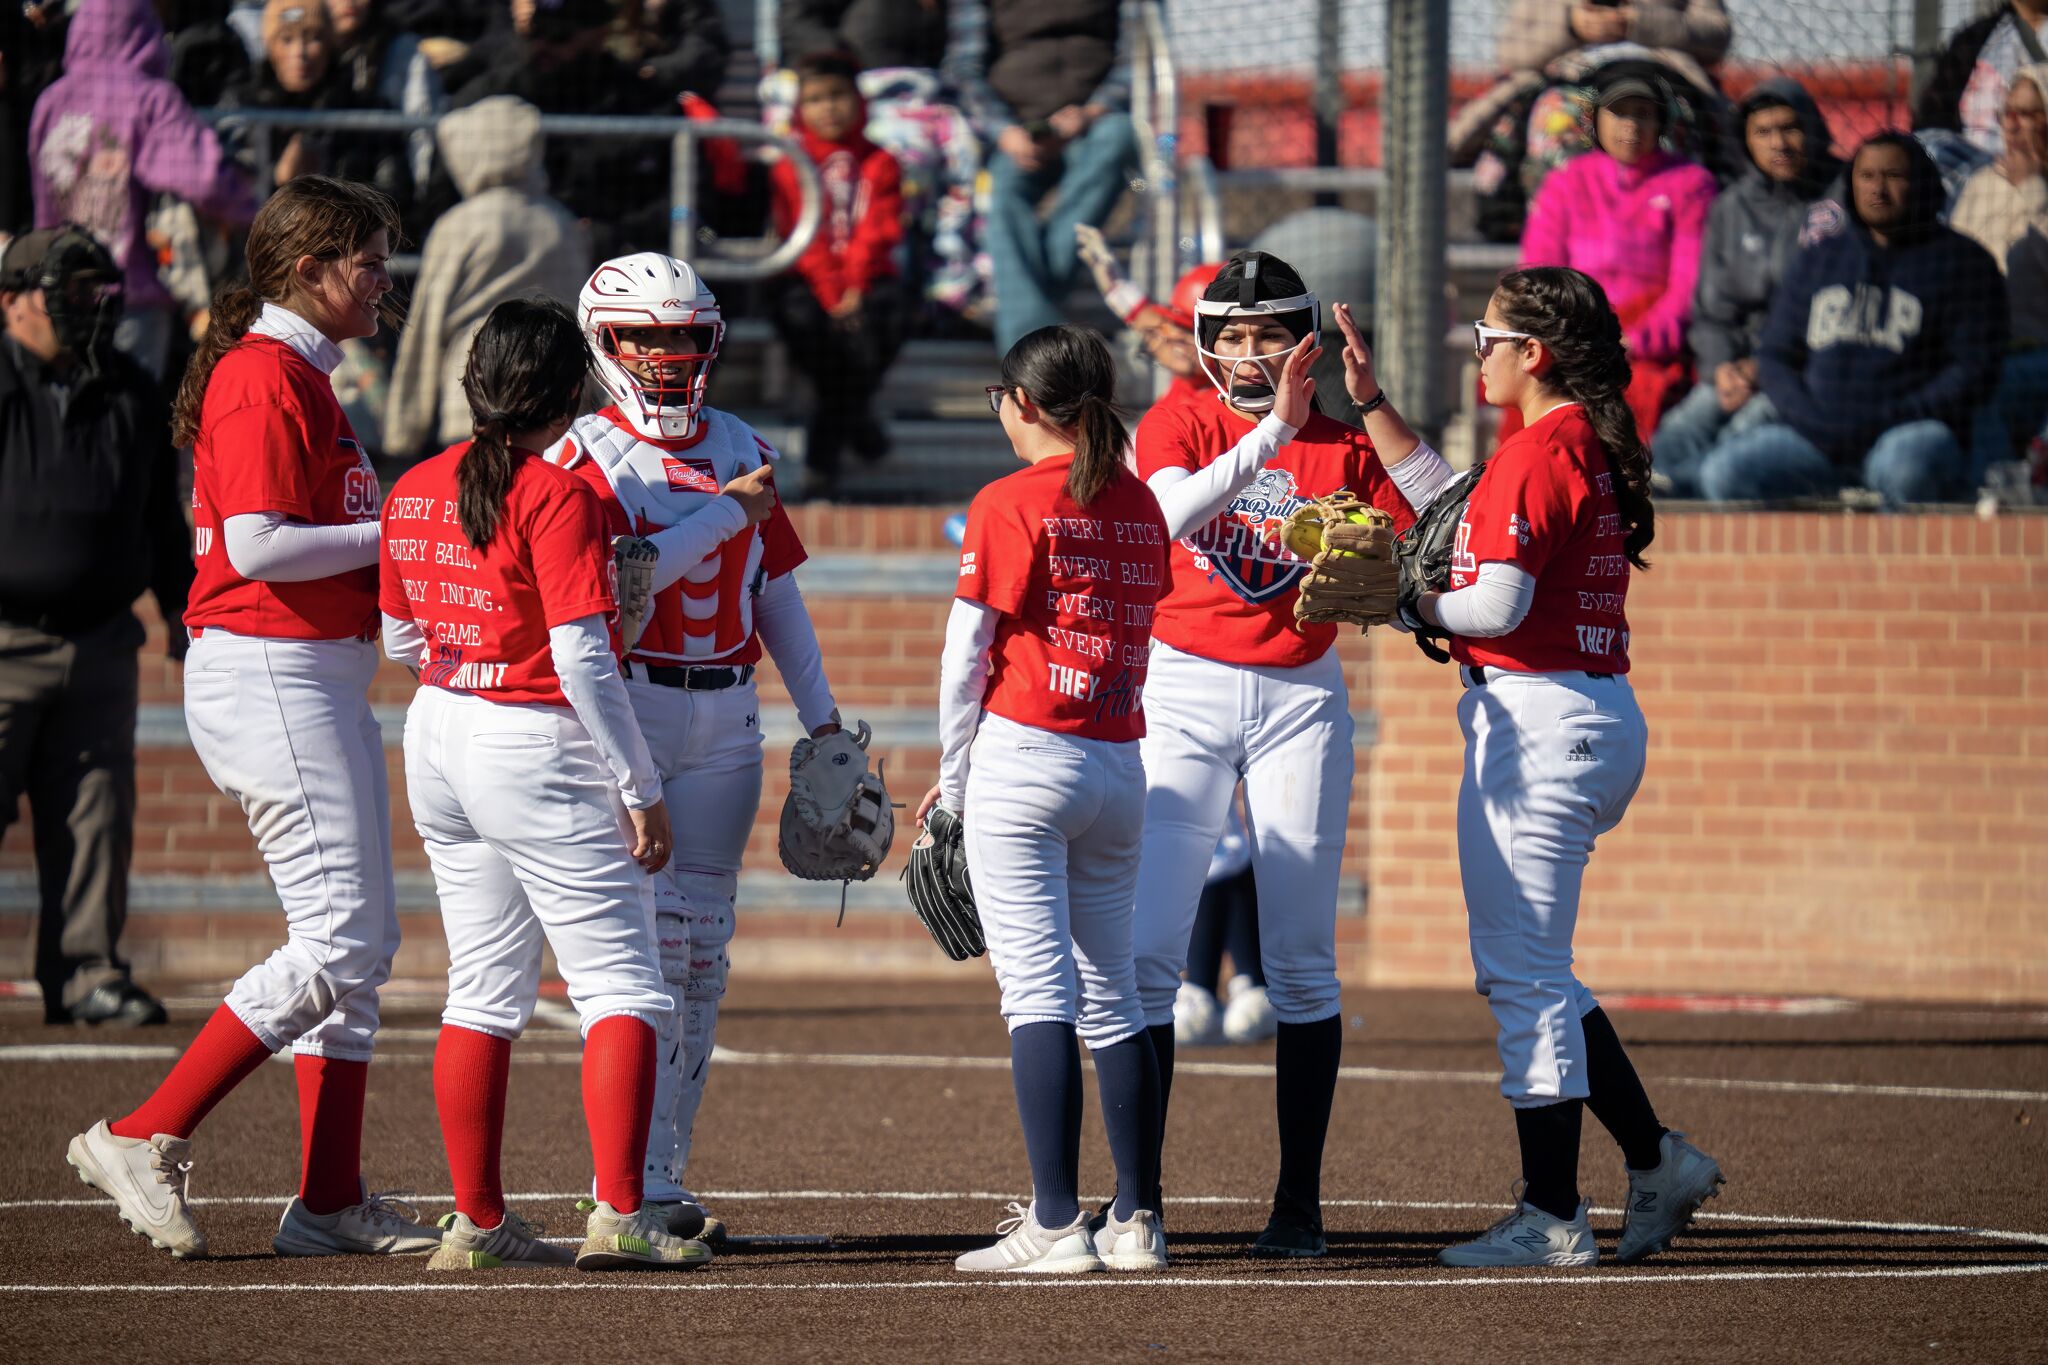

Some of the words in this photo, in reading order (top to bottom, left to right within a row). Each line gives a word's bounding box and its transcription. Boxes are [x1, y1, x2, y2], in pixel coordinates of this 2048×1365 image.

[388, 497, 435, 520] EVERY
[442, 501, 461, 524] PI
[1042, 518, 1108, 541] EVERY
[1114, 521, 1164, 545] PITCH.
[388, 538, 428, 561] EVERY
[435, 542, 477, 570] BALL.
[1193, 555, 1209, 571] 20
[1585, 556, 1629, 577] EVER
[1048, 556, 1111, 581] EVERY
[1122, 562, 1160, 587] BALL.
[1452, 573, 1468, 587] 25
[1047, 590, 1115, 621] EVERY
[436, 621, 481, 646] GAME
[1048, 626, 1117, 661] EVERY
[1575, 624, 1616, 655] THEY
[1048, 662, 1100, 702] THEY
[1565, 754, 1598, 762] adidas
